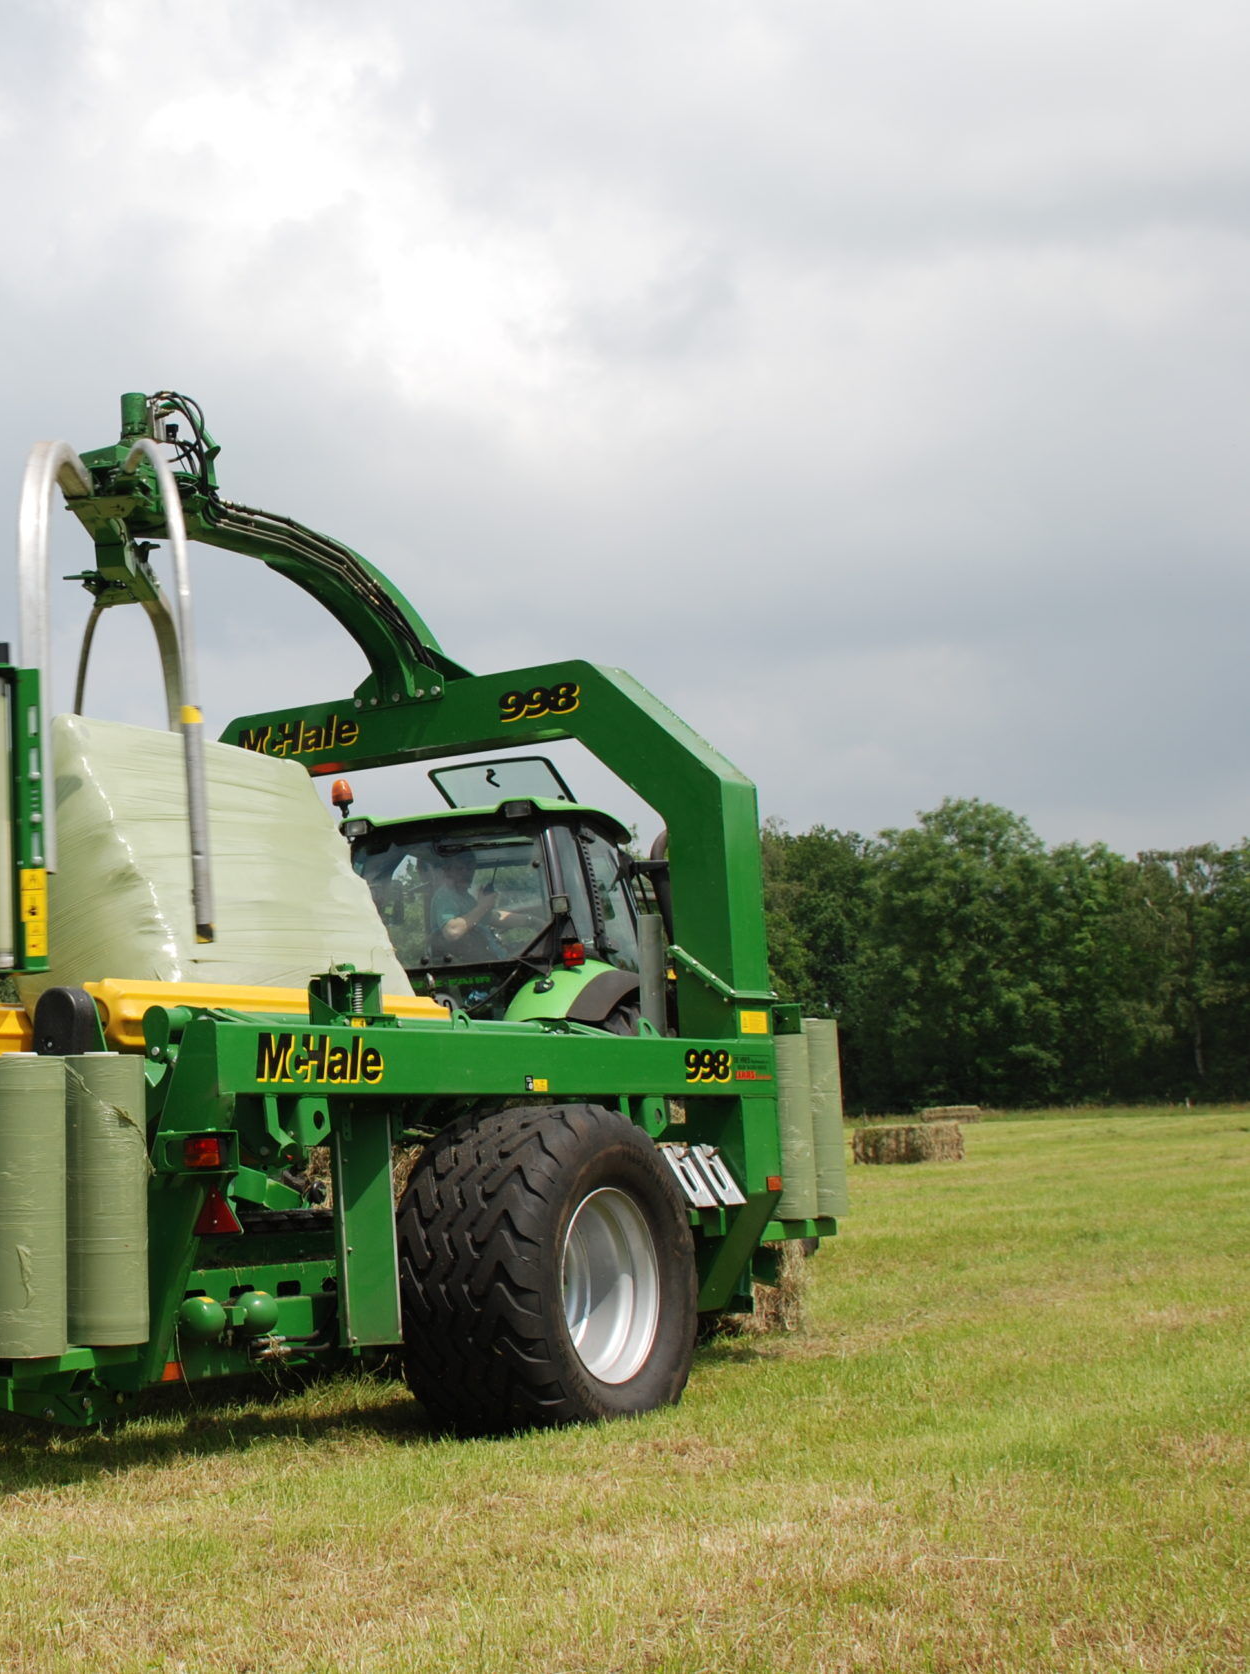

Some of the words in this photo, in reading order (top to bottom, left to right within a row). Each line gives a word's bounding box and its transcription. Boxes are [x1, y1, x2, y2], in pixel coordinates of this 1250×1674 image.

[498, 682, 580, 723] 998
[238, 714, 359, 757] McHale
[256, 1032, 384, 1084] McHale
[684, 1048, 733, 1083] 998
